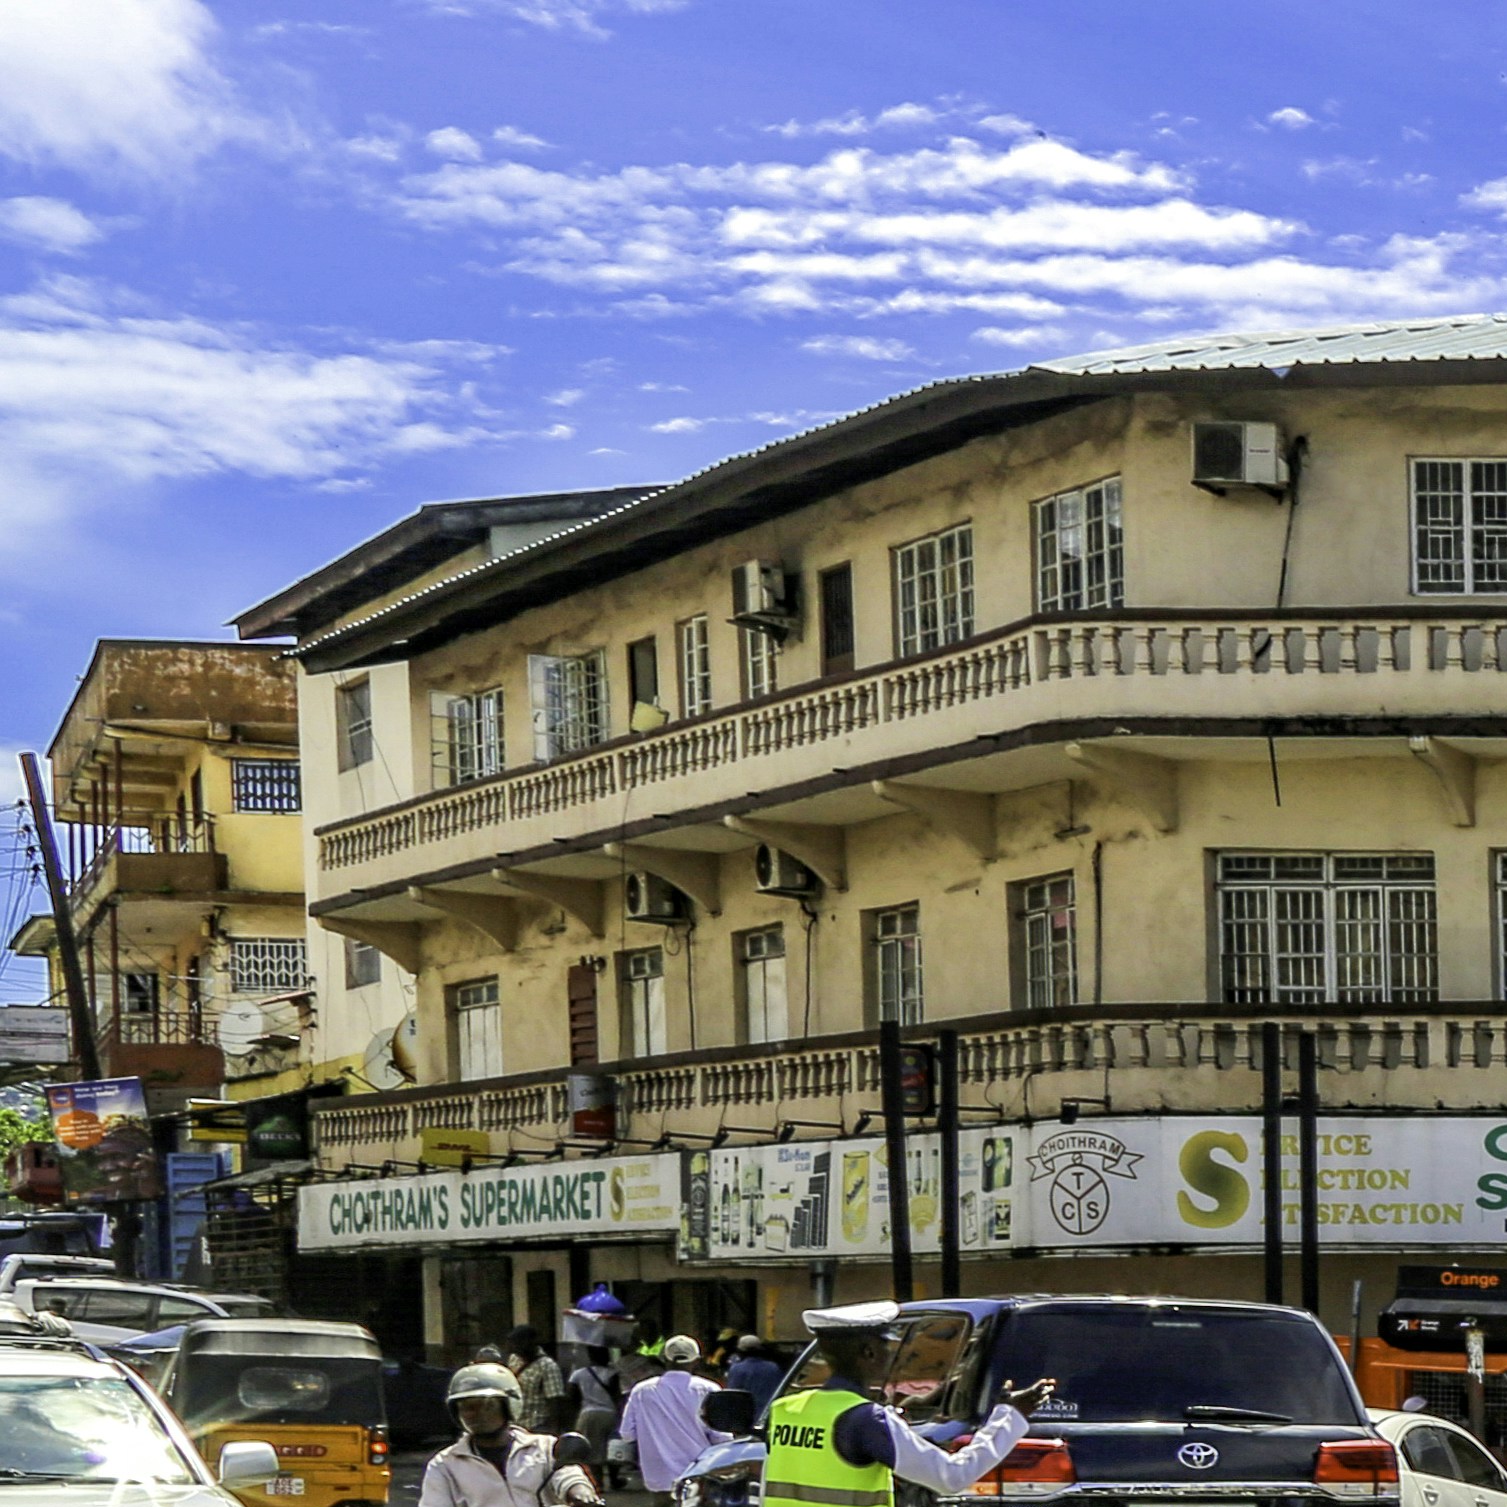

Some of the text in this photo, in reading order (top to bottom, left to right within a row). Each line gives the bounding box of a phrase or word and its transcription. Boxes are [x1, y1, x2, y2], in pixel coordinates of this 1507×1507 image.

[1041, 1136, 1121, 1157] CHOITHRAM
[1071, 1172, 1085, 1190] T
[329, 1171, 606, 1236] CHOITHRAM'S SUPERMARKET
[1061, 1201, 1100, 1220] C S
[1440, 1271, 1499, 1289] Orange
[772, 1424, 826, 1449] POLICE
